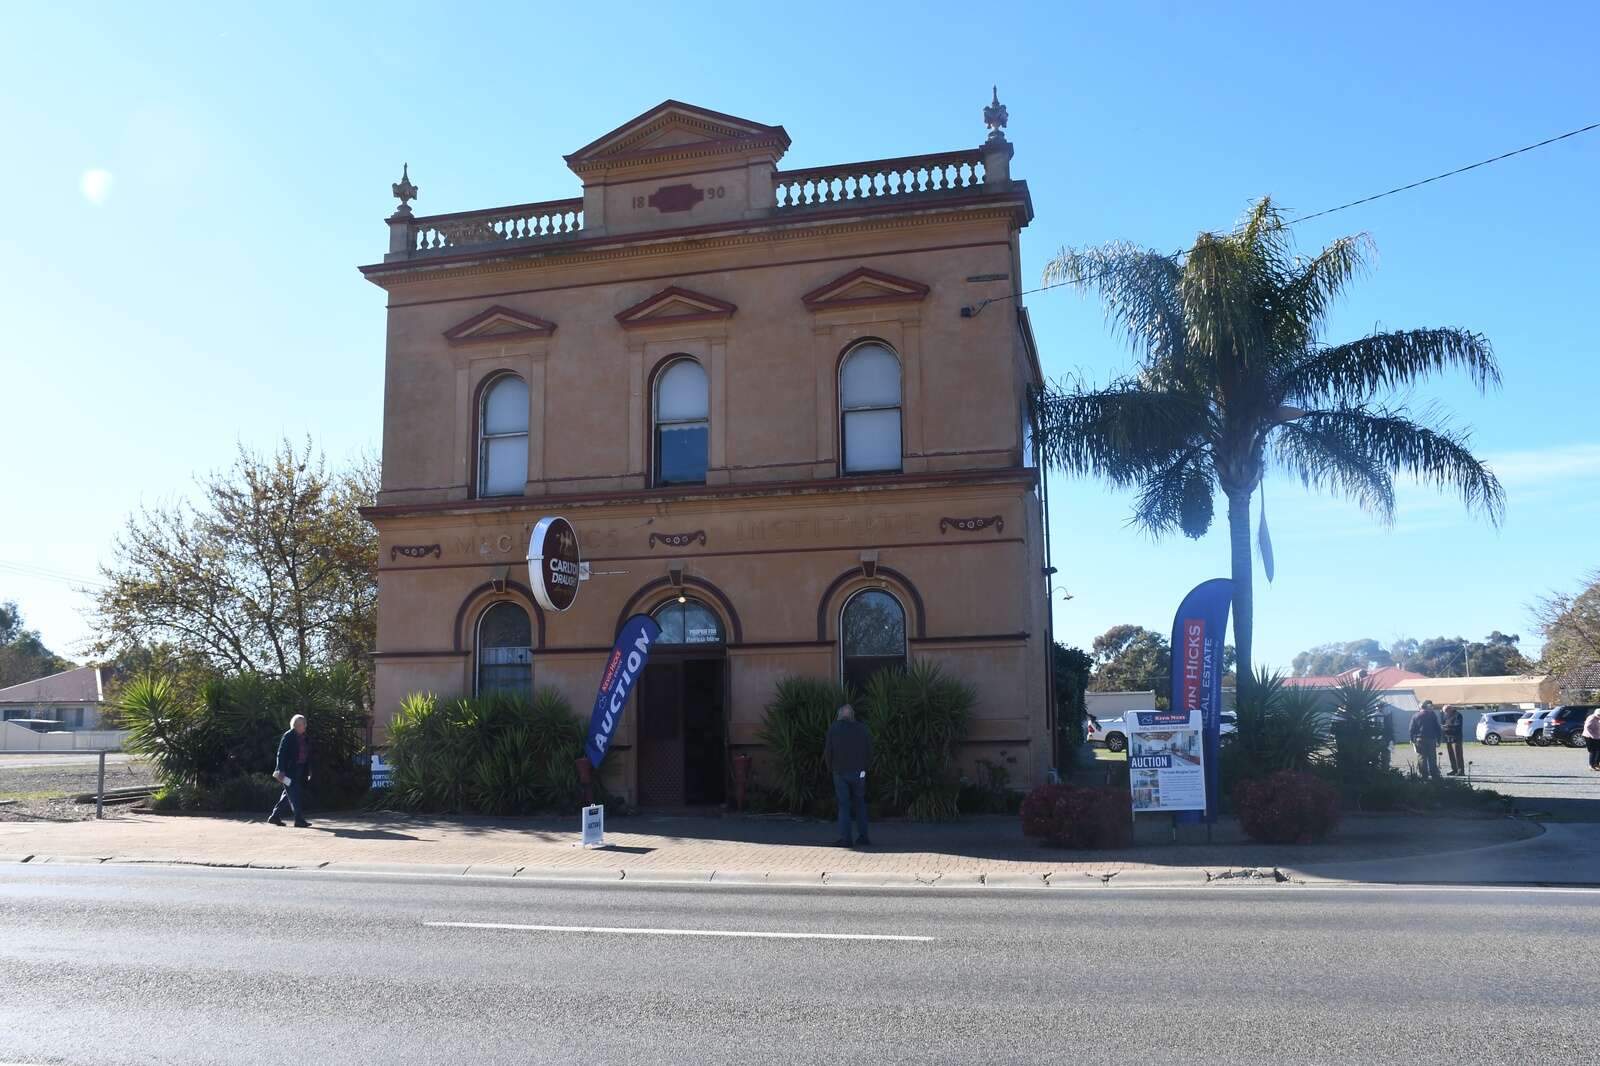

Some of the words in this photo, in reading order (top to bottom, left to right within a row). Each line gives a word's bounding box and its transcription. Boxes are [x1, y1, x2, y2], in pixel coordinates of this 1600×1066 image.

[632, 196, 645, 209] 18
[707, 186, 726, 200] 90
[1186, 624, 1201, 682] HICKS
[1202, 637, 1213, 688] ESTATE
[594, 627, 650, 753] AUCTION
[1131, 756, 1168, 768] AUCTION
